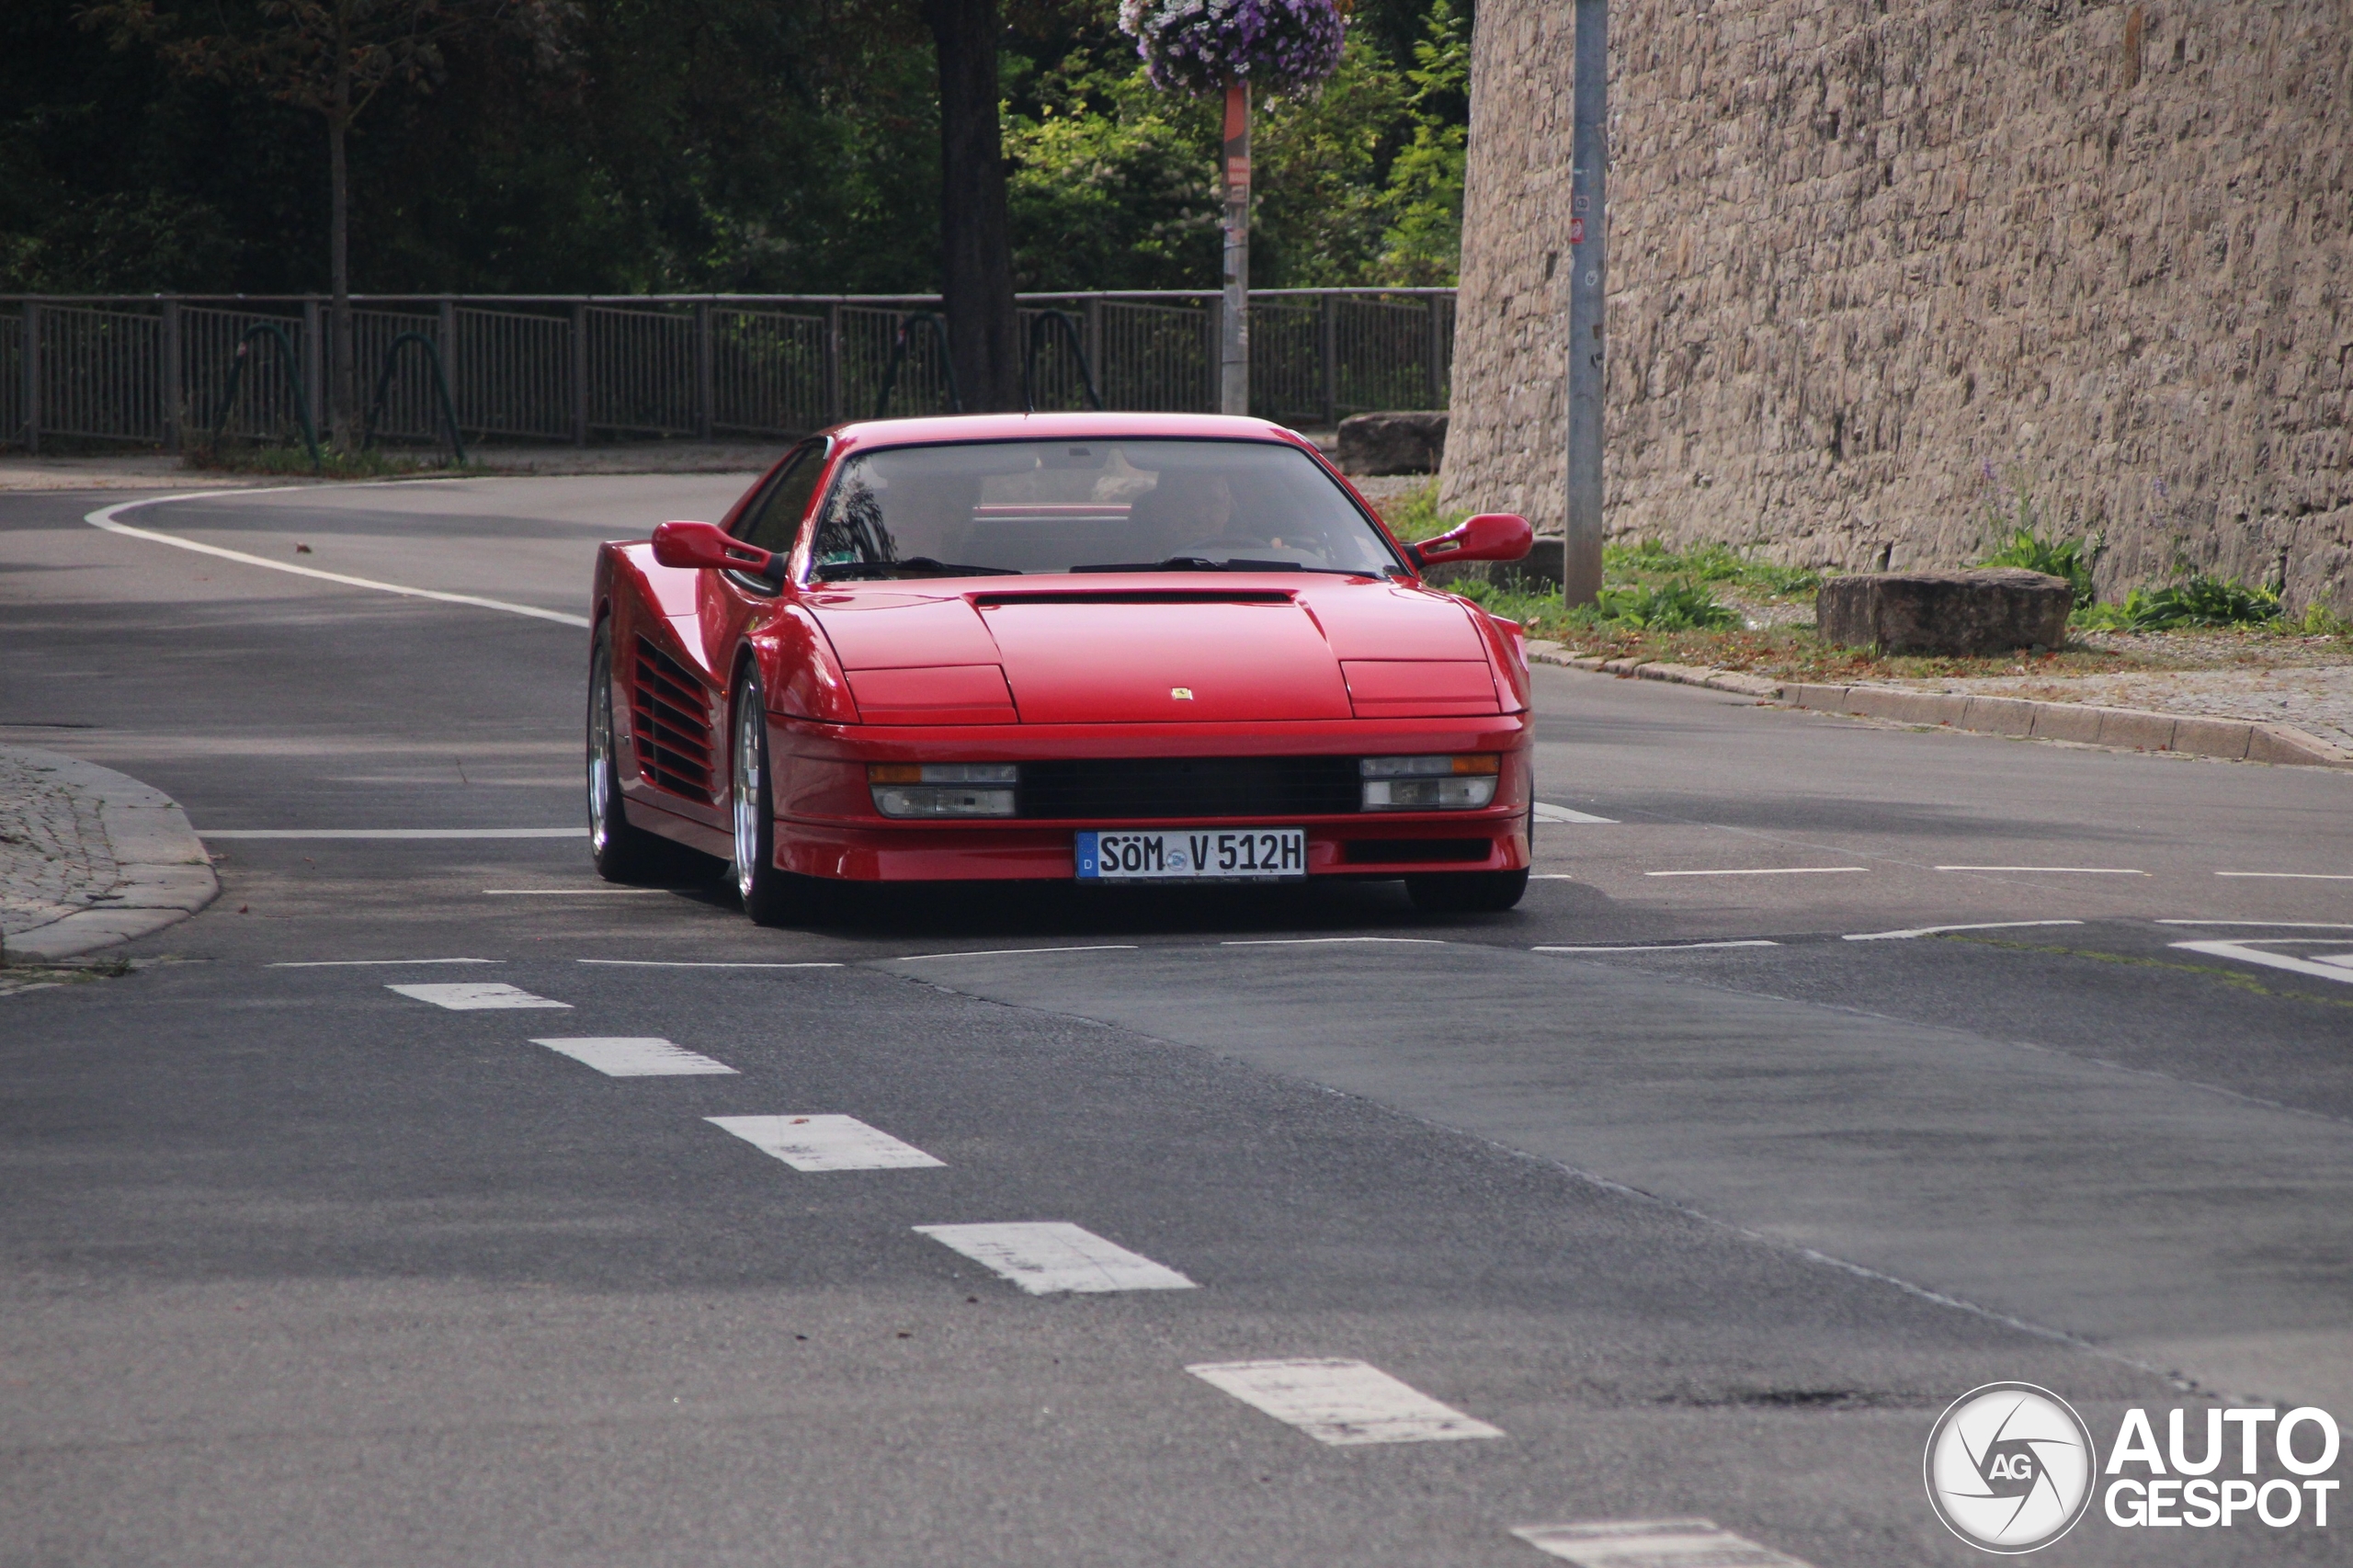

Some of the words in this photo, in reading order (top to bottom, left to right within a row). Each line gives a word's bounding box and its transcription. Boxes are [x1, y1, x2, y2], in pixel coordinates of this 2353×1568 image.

[1189, 835, 1209, 870] V
[1218, 834, 1302, 870] 512H
[1084, 859, 1093, 869] D
